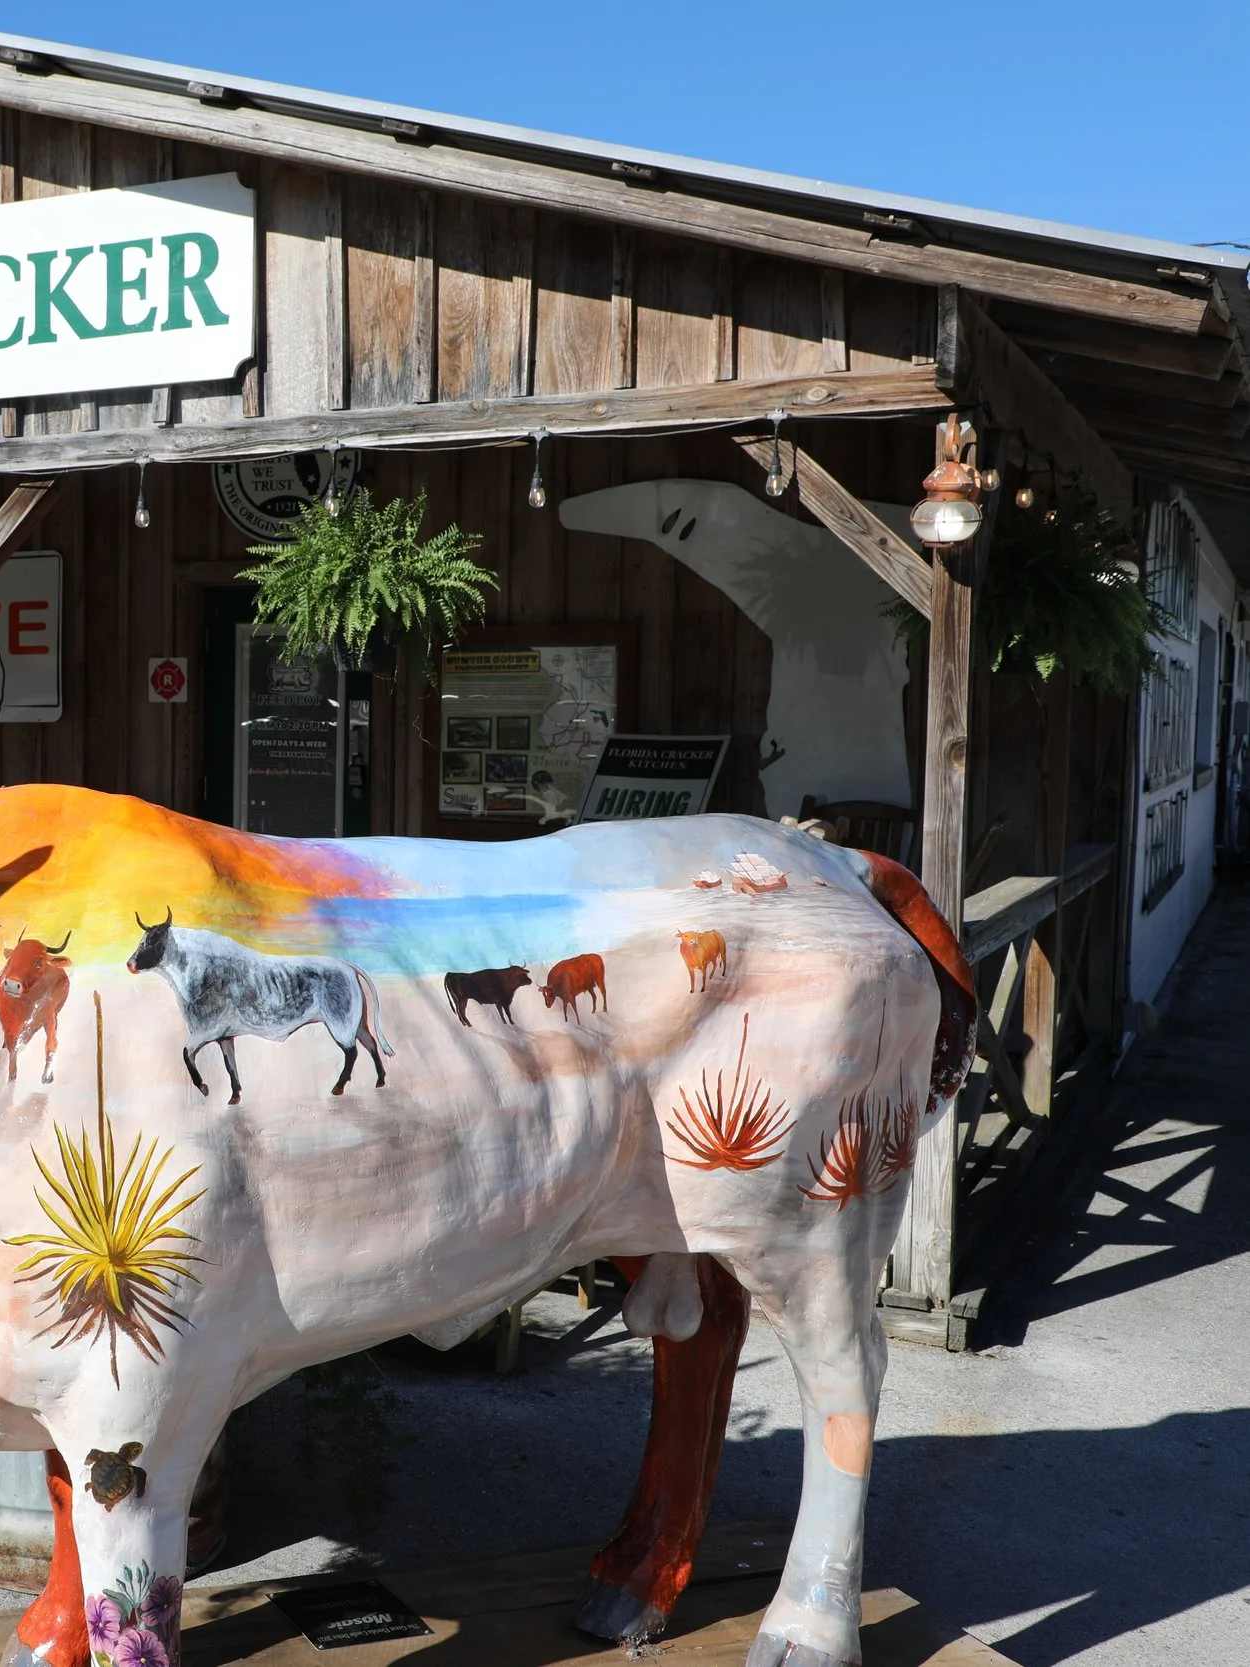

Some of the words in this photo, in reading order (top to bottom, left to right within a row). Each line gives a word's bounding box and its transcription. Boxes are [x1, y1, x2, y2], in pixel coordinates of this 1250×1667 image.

[252, 466, 274, 478] WE
[251, 478, 295, 491] TRUST
[224, 480, 242, 507] THE
[163, 674, 173, 686] R
[298, 740, 305, 748] A
[306, 740, 328, 748] WEEK
[609, 747, 657, 759] FLORIDA
[660, 749, 714, 759] CRACKER
[628, 760, 687, 769] KITCHEN
[595, 787, 692, 818] HIRING
[327, 1613, 393, 1630] Mosaic
